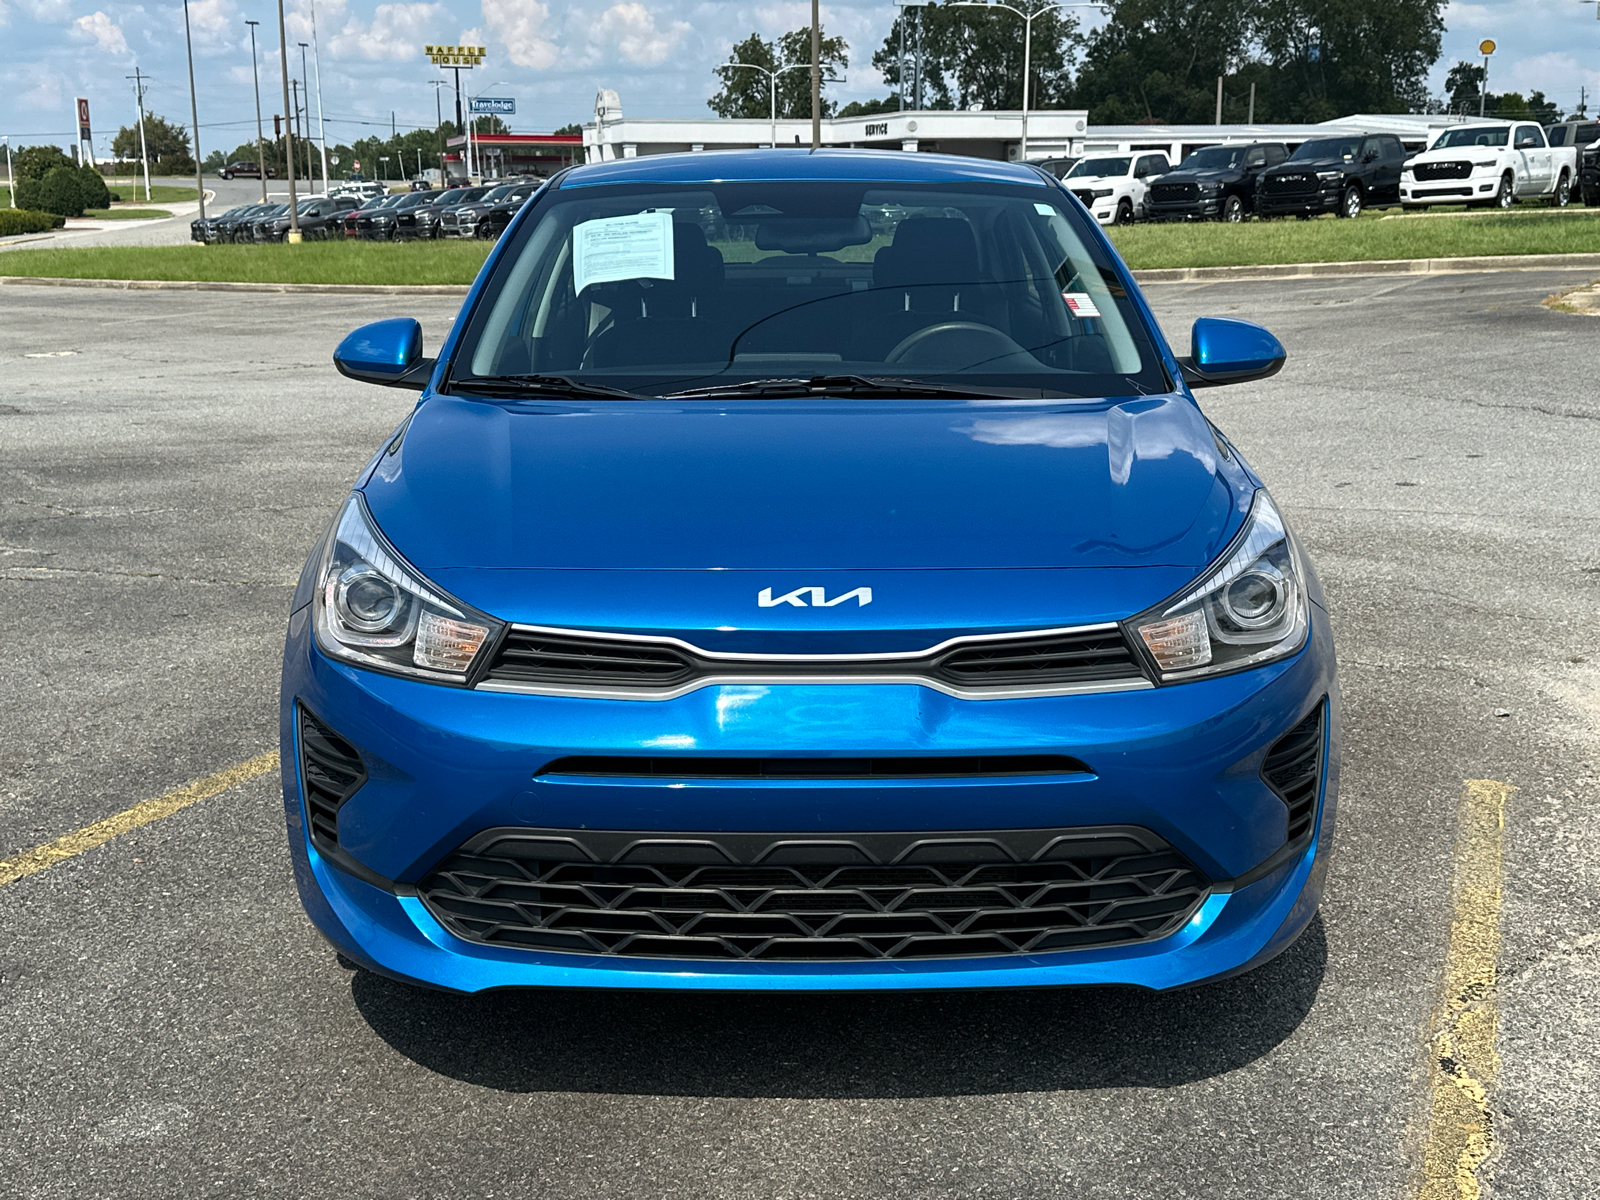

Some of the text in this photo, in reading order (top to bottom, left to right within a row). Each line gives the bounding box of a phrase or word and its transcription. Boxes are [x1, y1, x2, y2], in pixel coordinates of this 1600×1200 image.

[425, 45, 486, 55] WAFFLE
[431, 56, 481, 64] HOUSE
[470, 99, 513, 110] Travelodge
[865, 122, 888, 136] SERVICE
[758, 586, 872, 607] KIA
